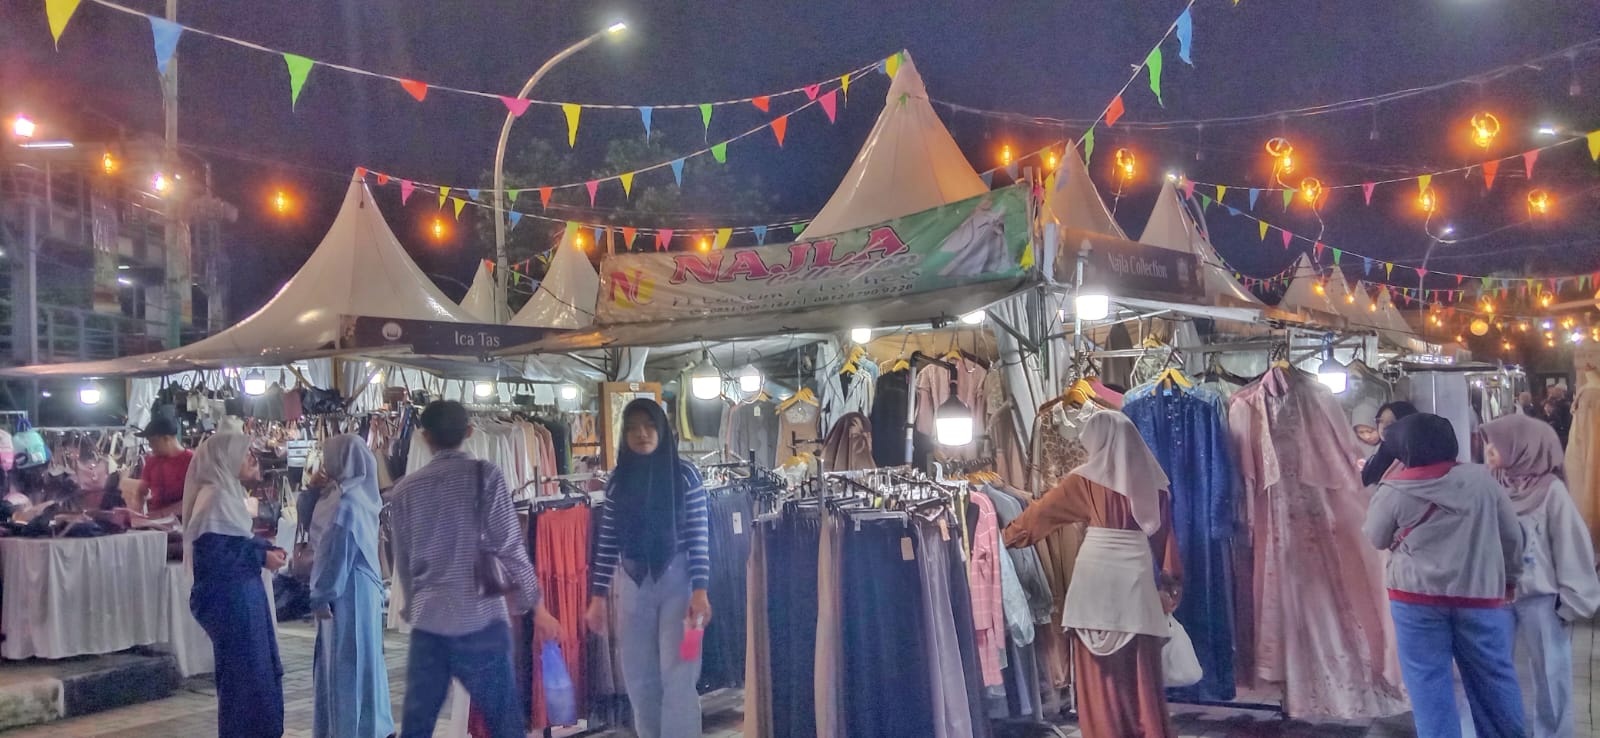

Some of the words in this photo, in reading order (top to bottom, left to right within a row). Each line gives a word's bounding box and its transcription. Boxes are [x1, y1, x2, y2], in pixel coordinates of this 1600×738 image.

[669, 226, 909, 284] NAJLA
[1108, 252, 1129, 277] Najla
[1130, 255, 1168, 279] Collection
[454, 330, 475, 346] Ica
[477, 332, 500, 348] Tas
